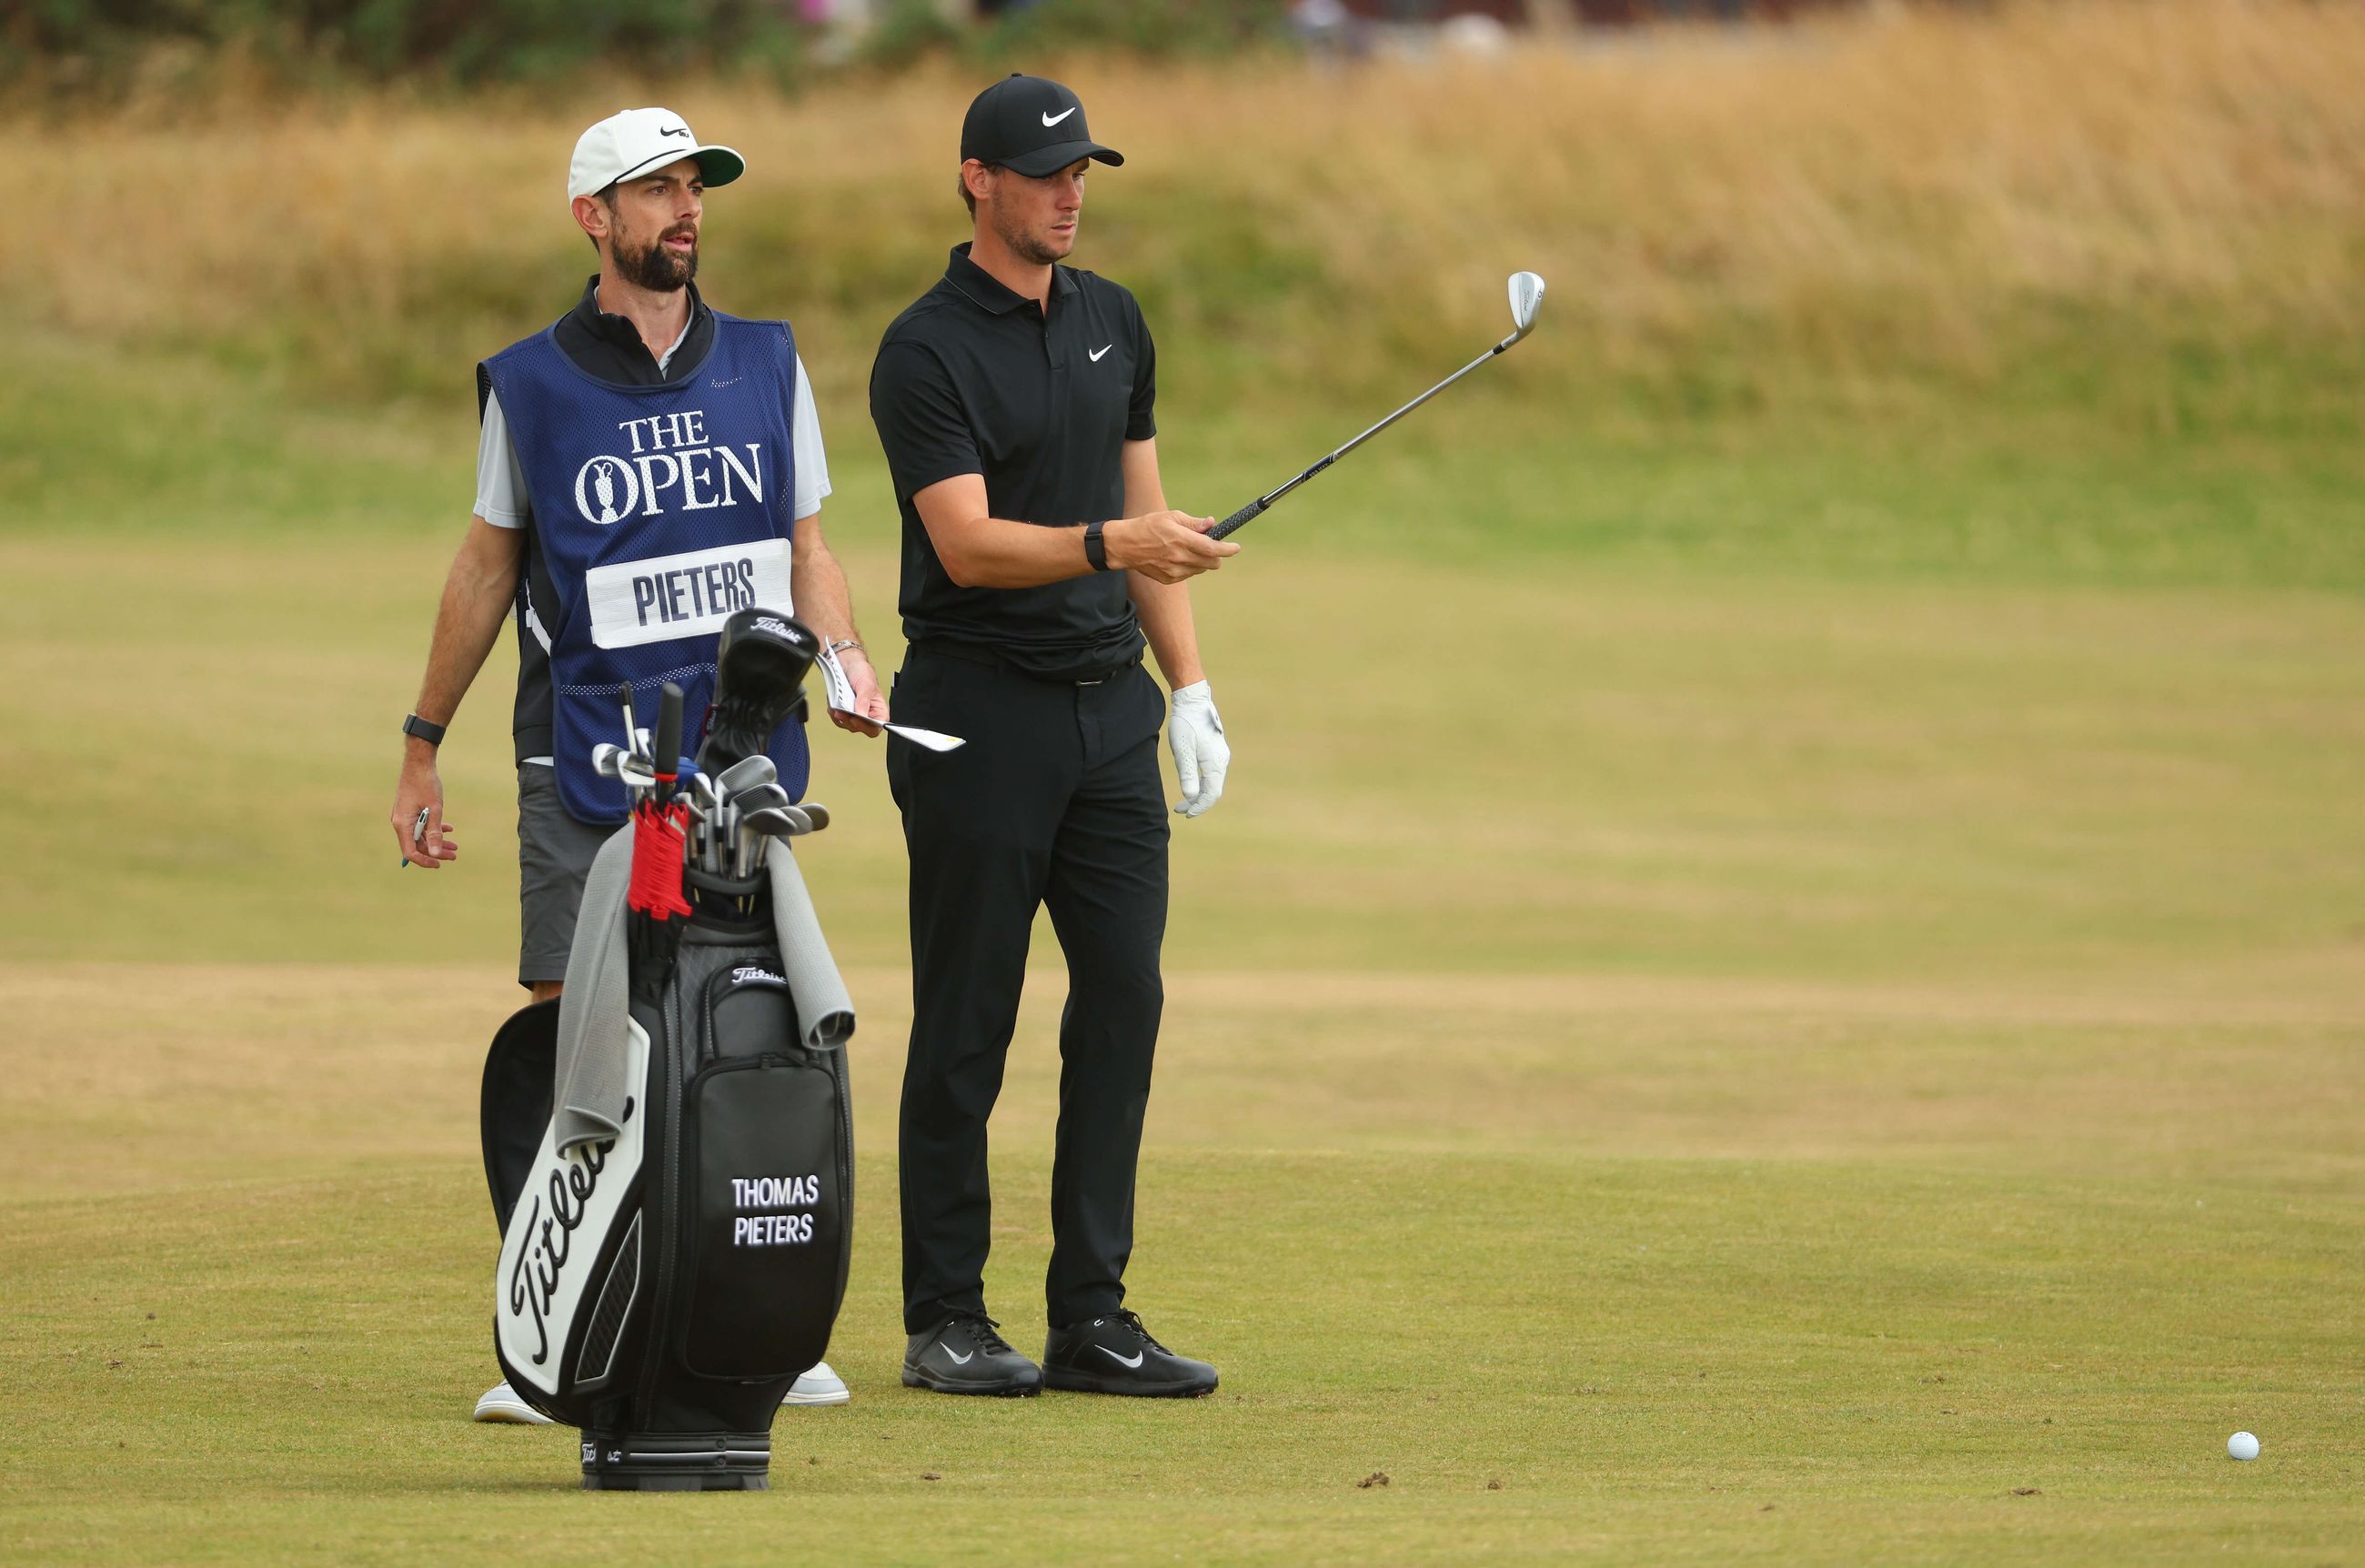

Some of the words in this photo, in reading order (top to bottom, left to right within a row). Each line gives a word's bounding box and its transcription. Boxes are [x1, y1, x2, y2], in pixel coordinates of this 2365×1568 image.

[619, 410, 710, 454] THE
[574, 443, 763, 524] OPEN
[632, 558, 756, 627] PIETERS
[750, 617, 802, 644] Titleist
[731, 1175, 820, 1207] THOMAS
[734, 1213, 814, 1245] PIETERS
